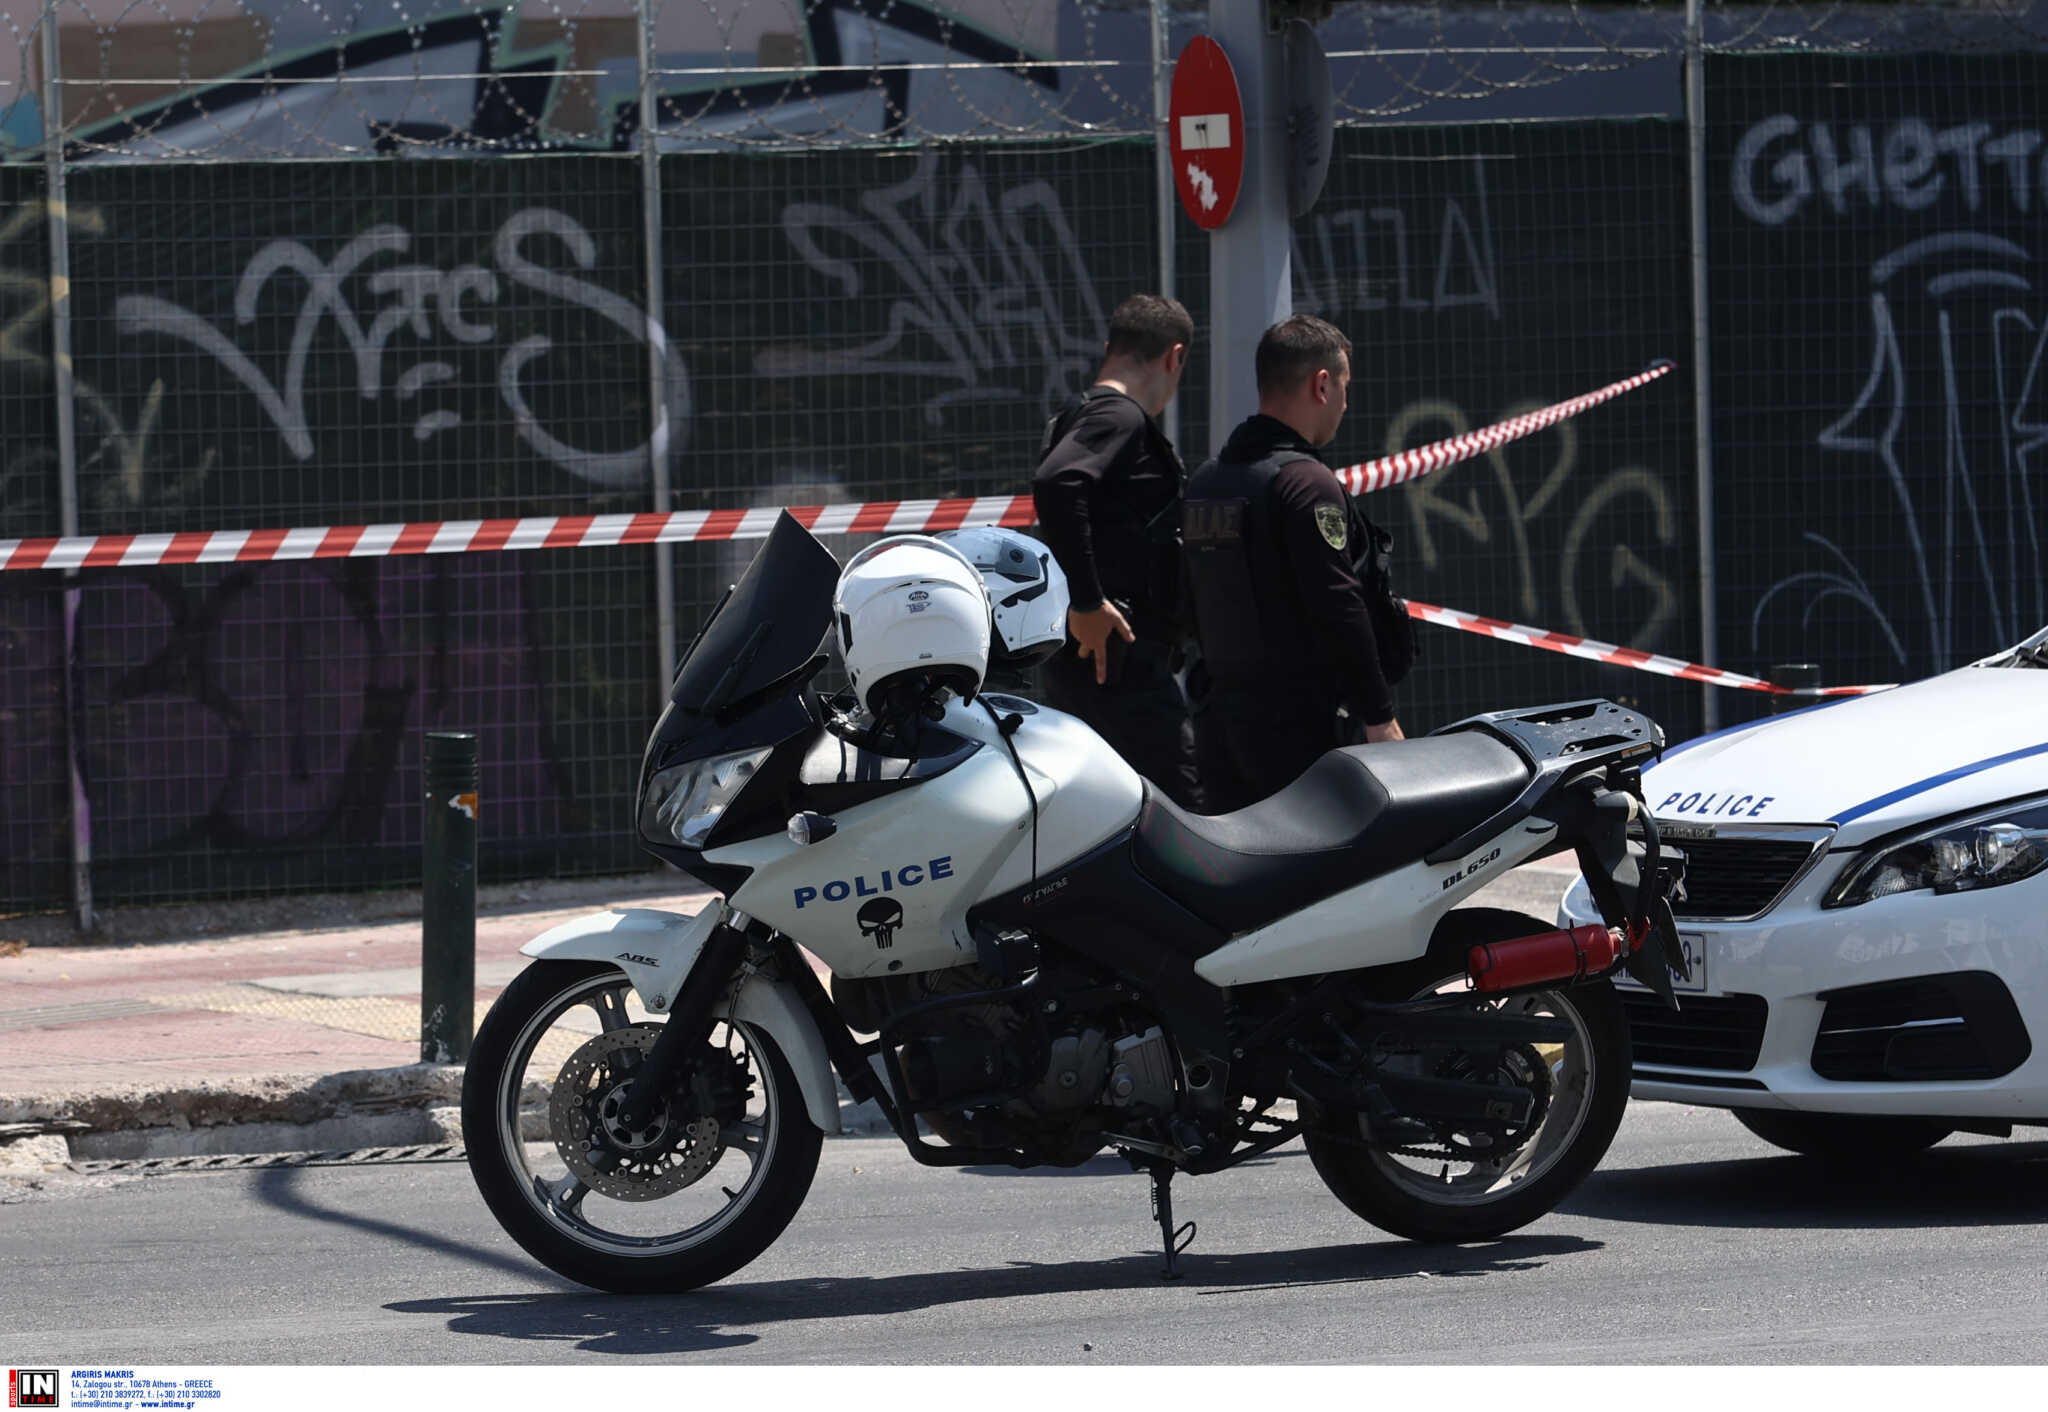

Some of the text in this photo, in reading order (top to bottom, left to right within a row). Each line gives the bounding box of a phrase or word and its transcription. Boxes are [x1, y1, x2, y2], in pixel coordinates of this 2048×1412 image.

[1730, 113, 2048, 226] GHeTT
[1656, 792, 1776, 816] POLICE
[794, 855, 954, 909] POLICE
